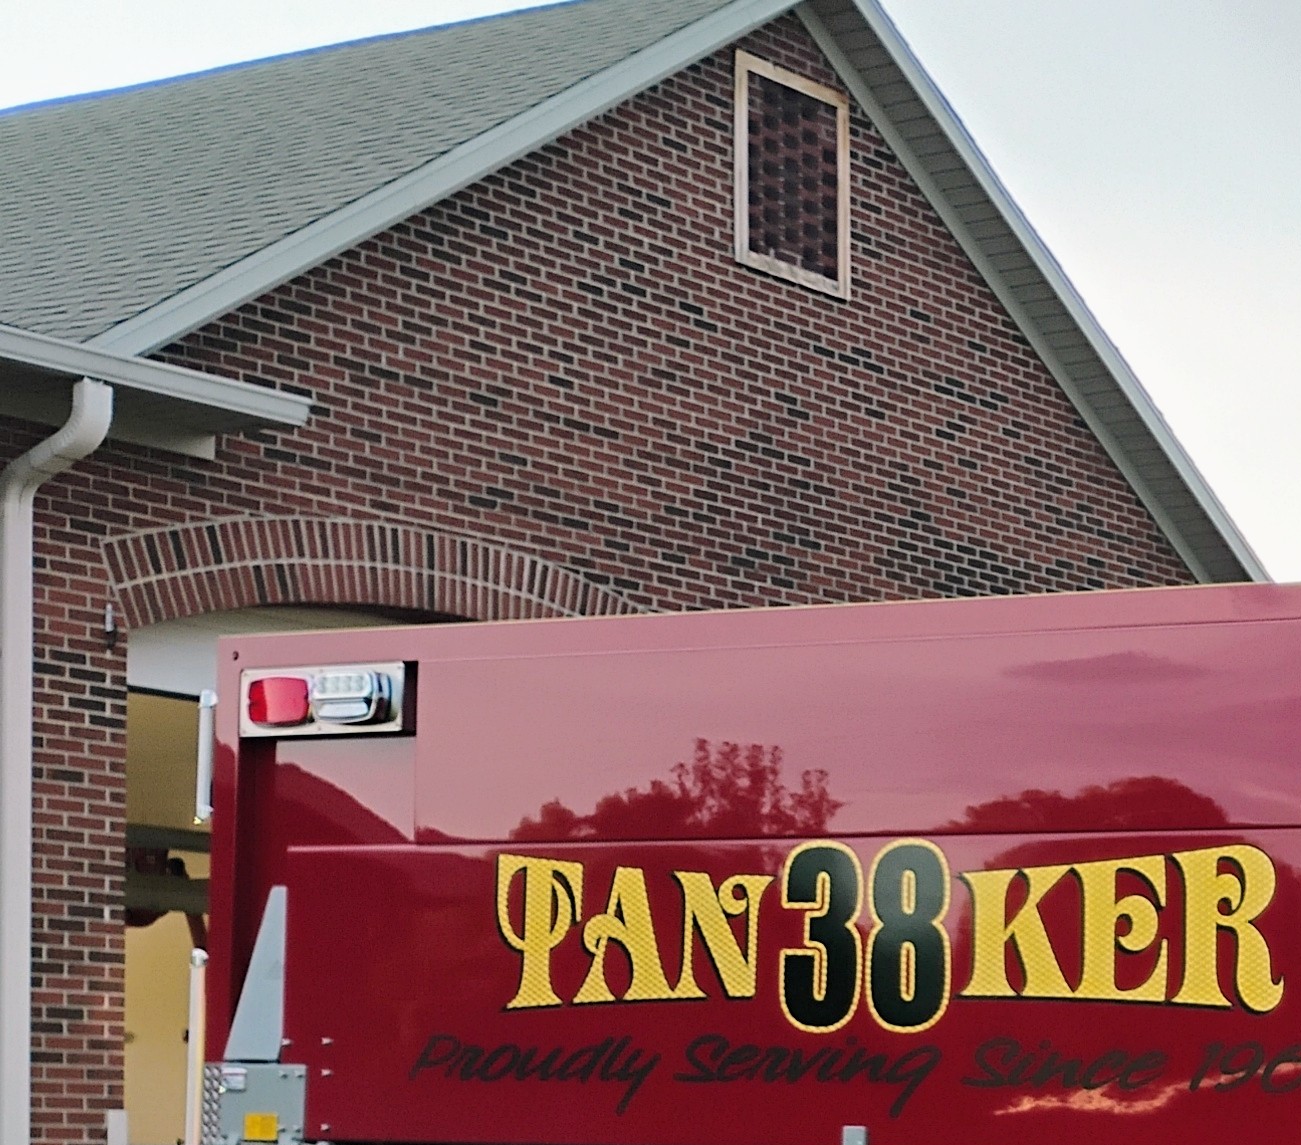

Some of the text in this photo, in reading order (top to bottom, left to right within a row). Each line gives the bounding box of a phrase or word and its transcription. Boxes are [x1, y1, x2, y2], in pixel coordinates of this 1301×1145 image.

[408, 1032, 663, 1117] Proudly
[672, 1032, 942, 1119] Serving
[961, 1036, 1169, 1092] Since
